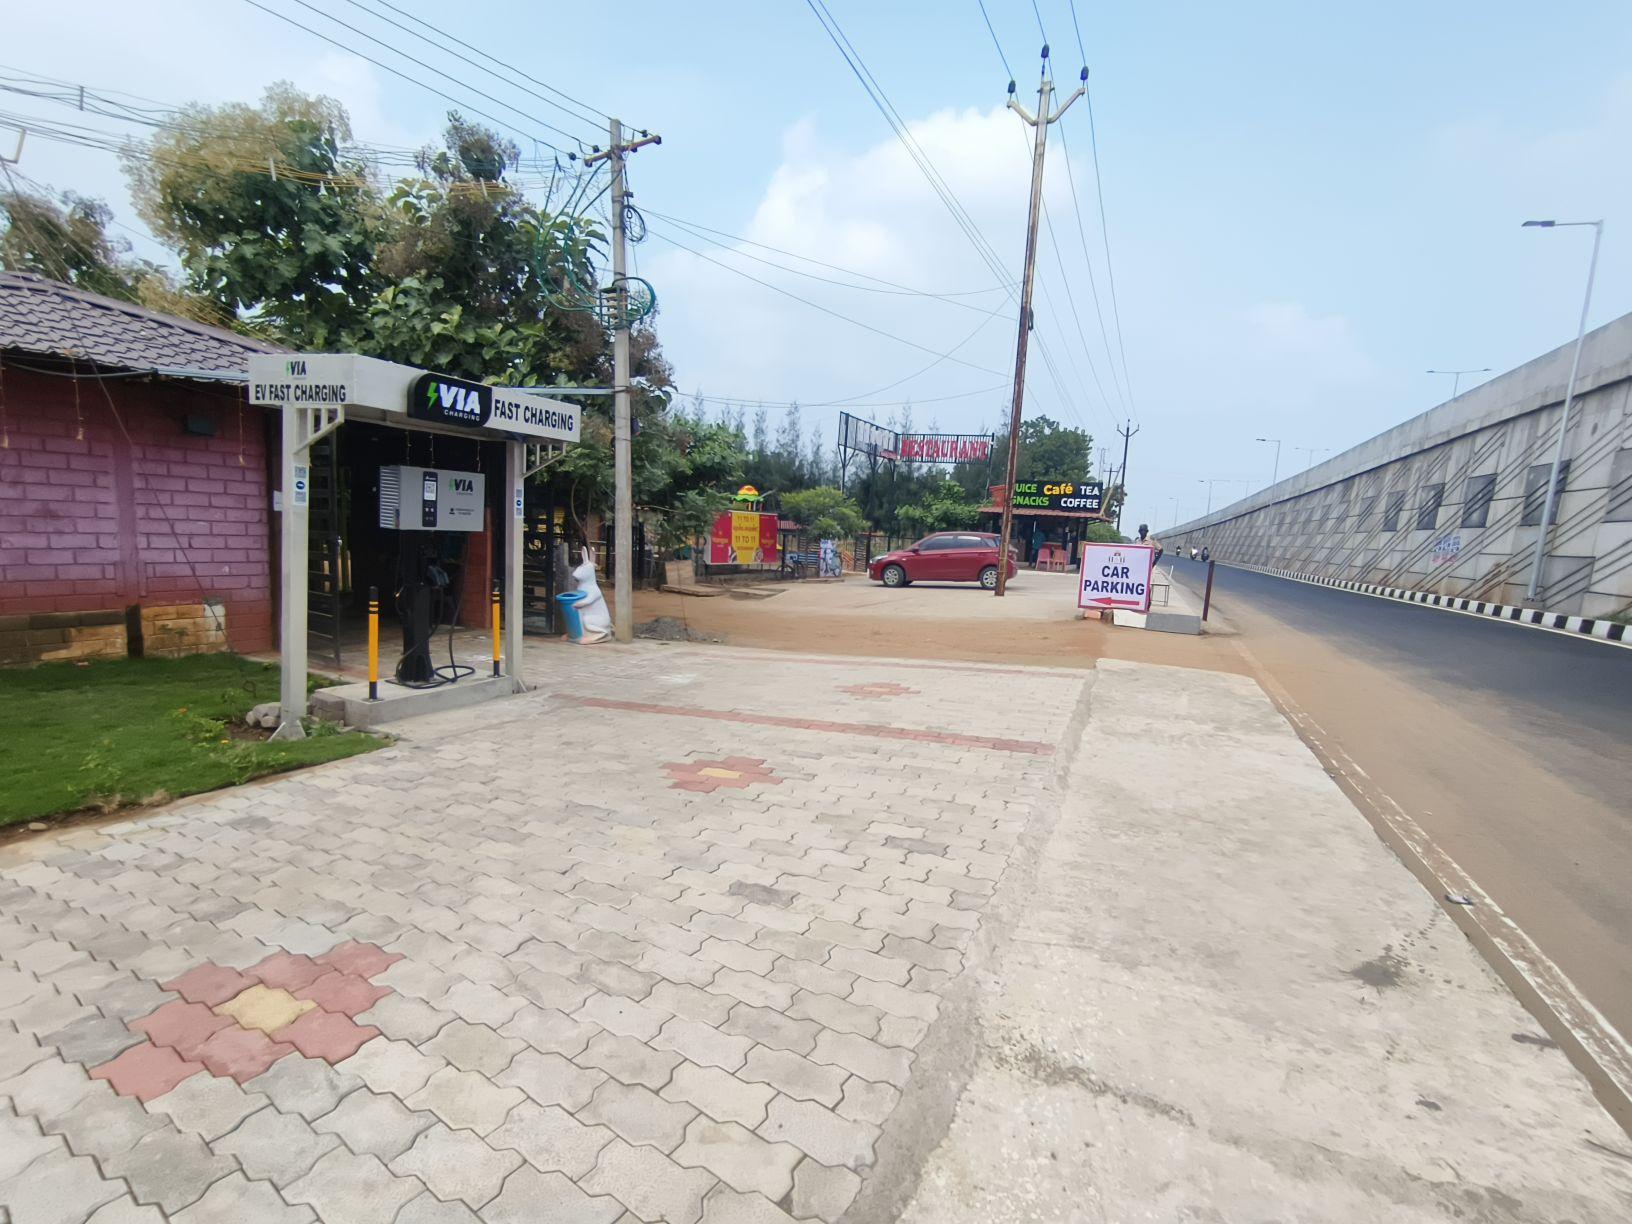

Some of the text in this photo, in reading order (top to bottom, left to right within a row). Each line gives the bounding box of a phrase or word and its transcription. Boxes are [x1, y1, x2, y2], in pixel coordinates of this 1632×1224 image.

[290, 361, 307, 375] VIA
[255, 384, 346, 402] EV FAST CHARGING
[438, 383, 480, 414] VIA
[444, 409, 480, 422] CHARGING
[494, 399, 574, 432] FAST CHARGING
[901, 438, 988, 460] RESTAURANT
[454, 478, 473, 492] VIA
[1043, 482, 1073, 495] Café
[1080, 485, 1100, 496] TEA
[1060, 498, 1099, 509] COFFEE
[742, 535, 750, 544] TO
[1101, 565, 1130, 579] CAR
[1083, 579, 1145, 596] PARKING
